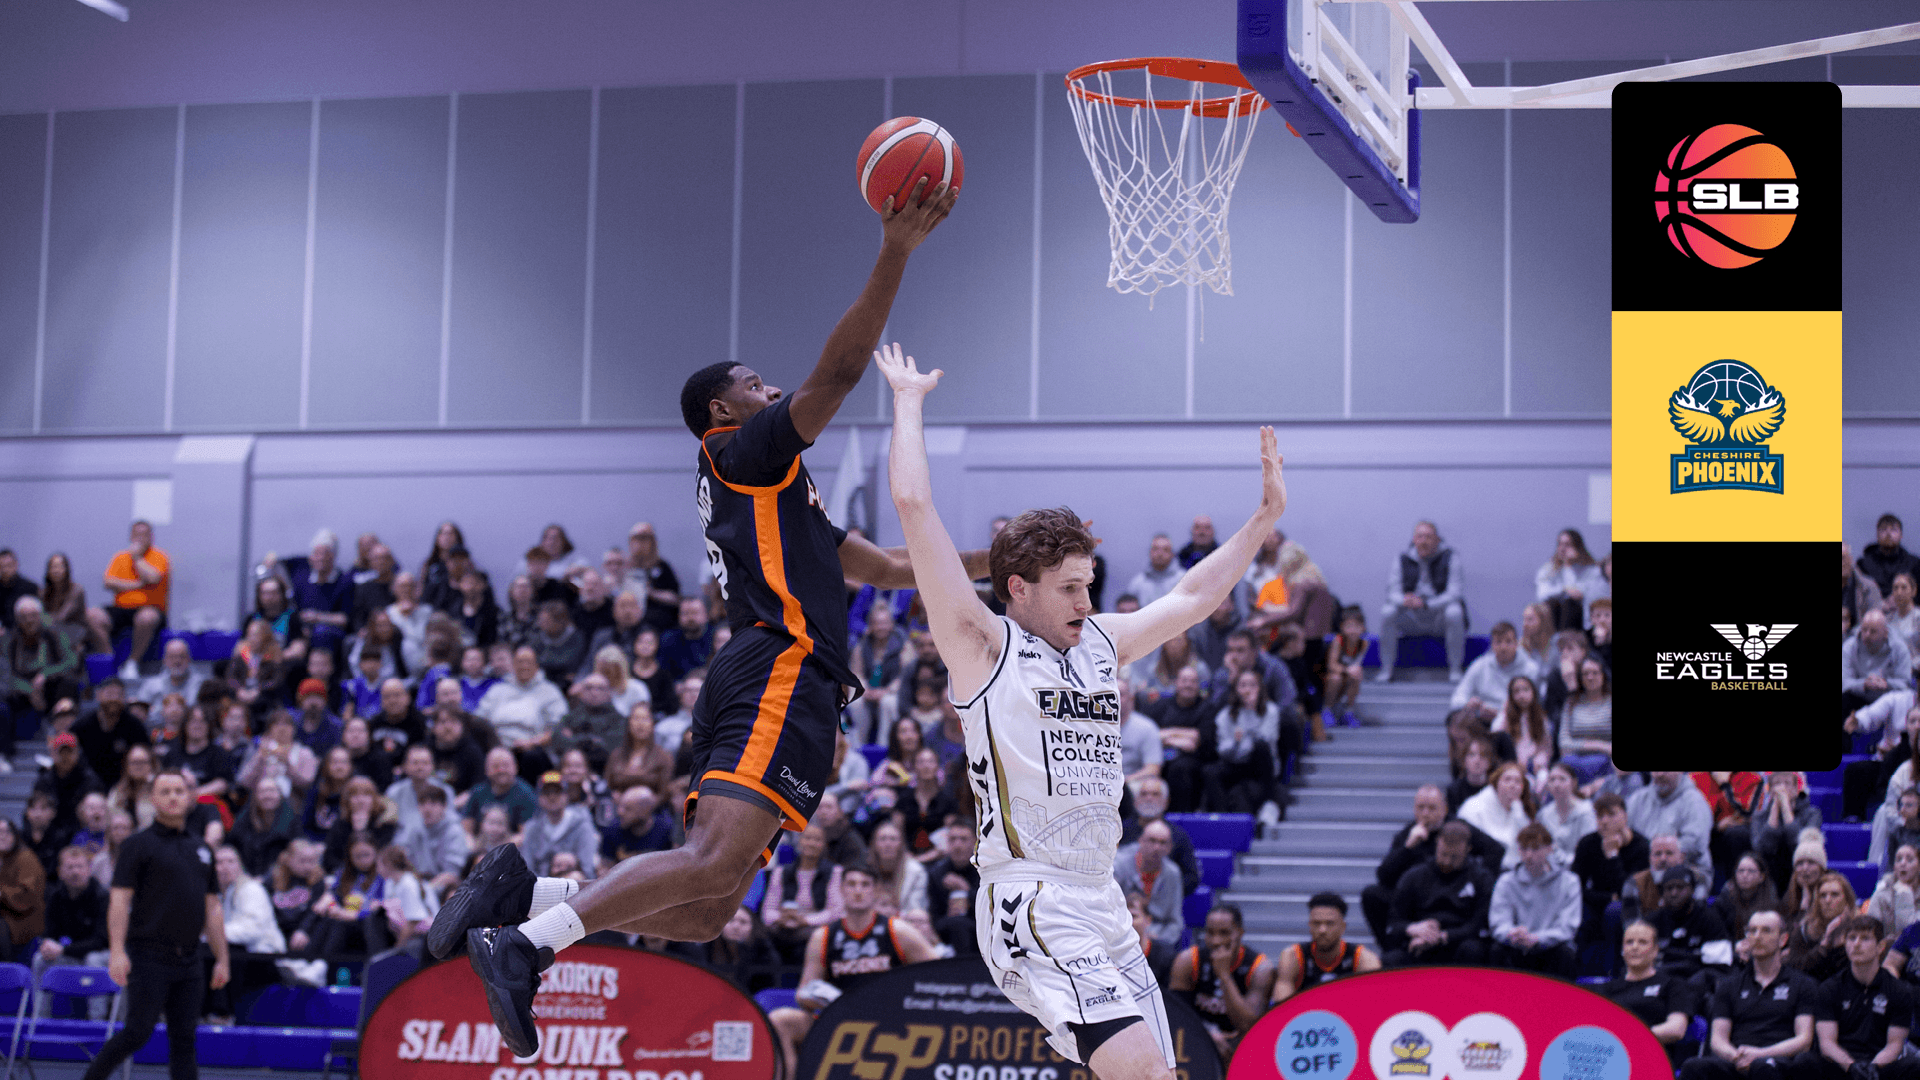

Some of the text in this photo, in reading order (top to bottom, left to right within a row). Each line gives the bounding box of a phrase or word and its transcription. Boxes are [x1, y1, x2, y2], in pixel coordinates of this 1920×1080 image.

[1036, 689, 1119, 722] EAGLES
[1051, 747, 1118, 765] COLLEGE
[1054, 765, 1121, 781] UNIVERSI
[1056, 782, 1113, 797] CENTRE
[537, 961, 619, 1000] CKORYS
[1290, 1027, 1339, 1050] 20%
[1290, 1052, 1342, 1075] OFF
